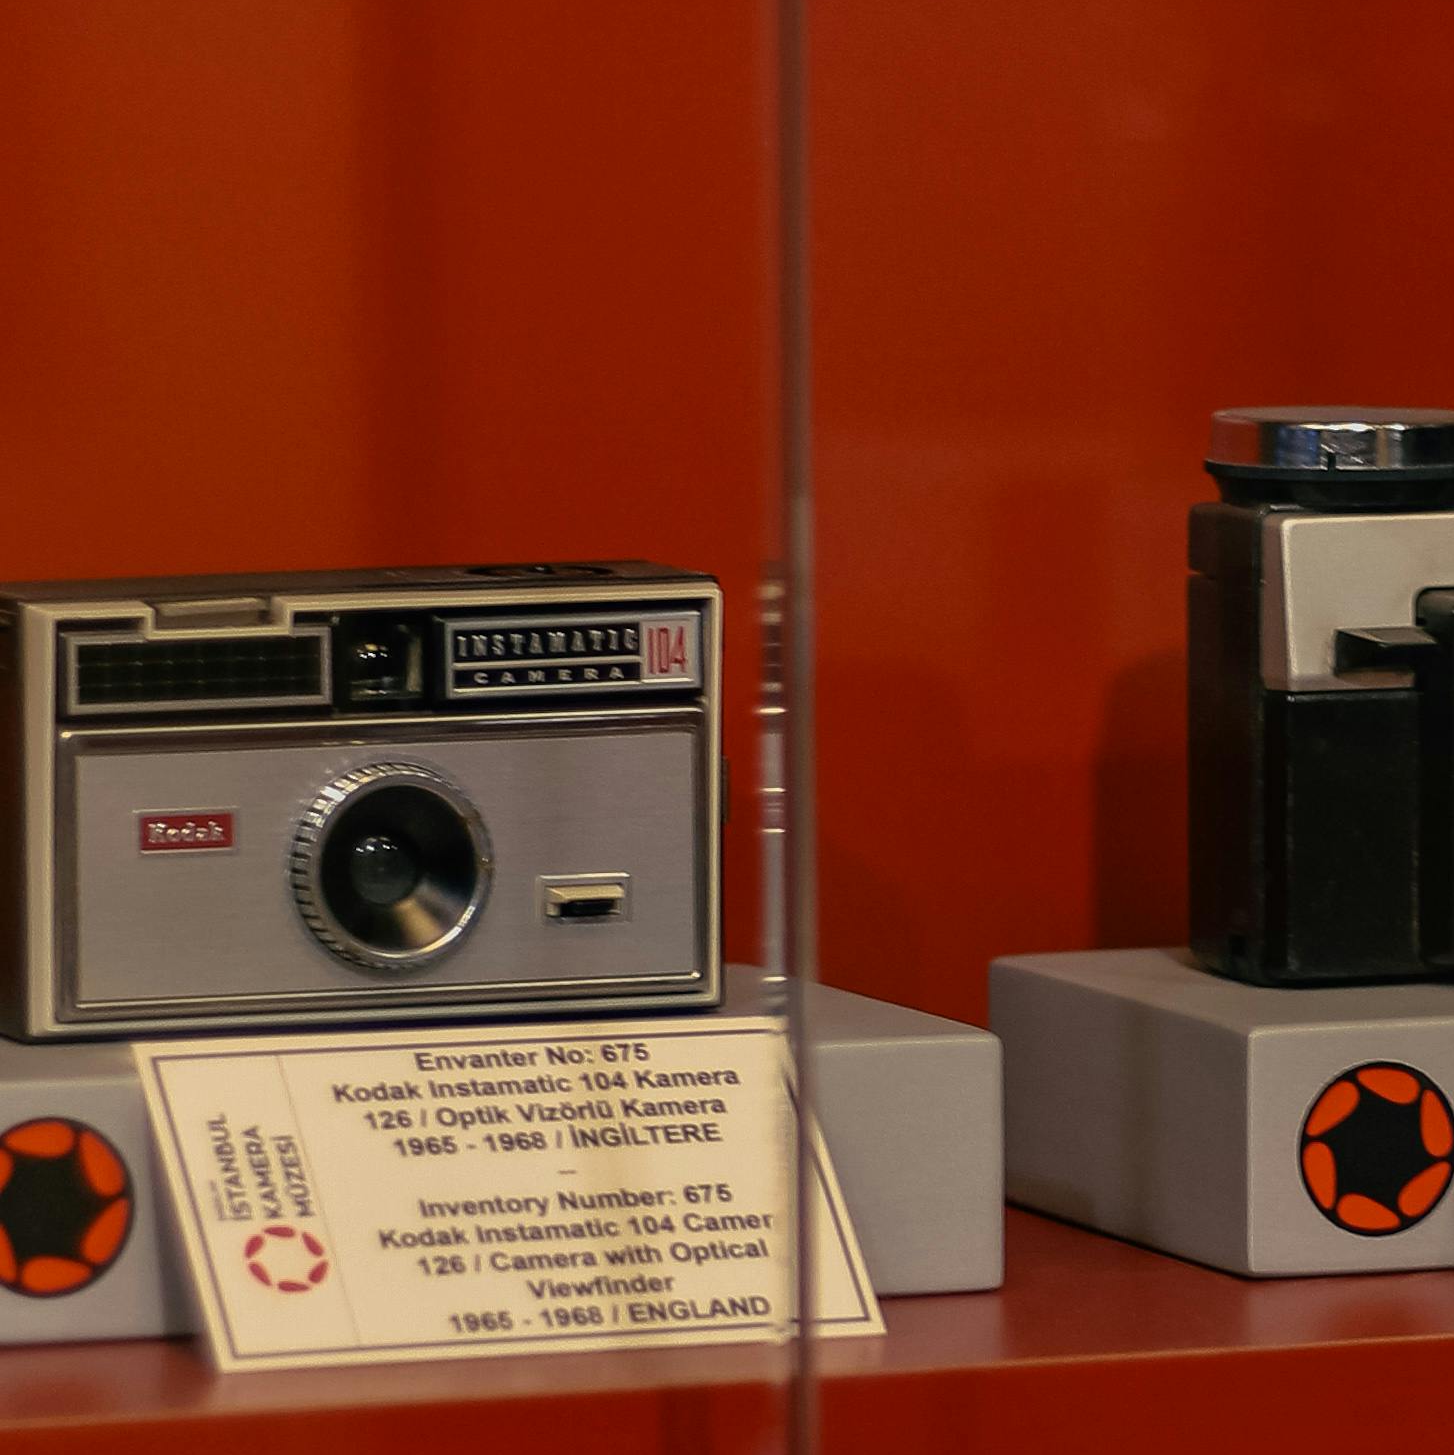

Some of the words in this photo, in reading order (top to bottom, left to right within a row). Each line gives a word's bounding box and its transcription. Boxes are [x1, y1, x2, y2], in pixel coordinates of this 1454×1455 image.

[456, 628, 639, 658] INSTAMATIC
[647, 626, 687, 674] 104
[473, 666, 625, 685] CAMERA
[147, 820, 224, 844] Kodak
[414, 1049, 538, 1071] Envanter
[544, 1045, 595, 1065] No:
[600, 1042, 650, 1063] 675
[331, 1081, 423, 1103] Kodak
[426, 1073, 572, 1099] Instamatic
[578, 1071, 628, 1091] 104
[632, 1068, 741, 1089] Kamera
[363, 1109, 413, 1130] 126
[434, 1105, 512, 1129] Optik
[515, 1099, 614, 1122] Vizörlü
[619, 1097, 727, 1117] Kamera
[393, 1135, 458, 1156] 1965
[482, 1131, 547, 1152] 1968
[567, 1120, 723, 1148] İNGİLTERE
[206, 1113, 253, 1220] İSTANBUL
[240, 1126, 284, 1219] KAMERA
[270, 1135, 315, 1217] MÜZESİ
[418, 1196, 549, 1217] Inventory
[556, 1188, 677, 1211] Number:
[682, 1183, 733, 1204] 675
[379, 1226, 470, 1248] Kodak
[474, 1218, 620, 1244] Instamatic
[627, 1214, 675, 1235] 104
[417, 1254, 467, 1275] 126
[489, 1250, 598, 1272] Camera
[603, 1244, 663, 1265] with
[669, 1237, 769, 1265] Optical
[526, 1274, 675, 1299] Viewfinder
[449, 1311, 515, 1333] 1965
[539, 1305, 604, 1327] 1968
[626, 1295, 772, 1322] ENGLAND
